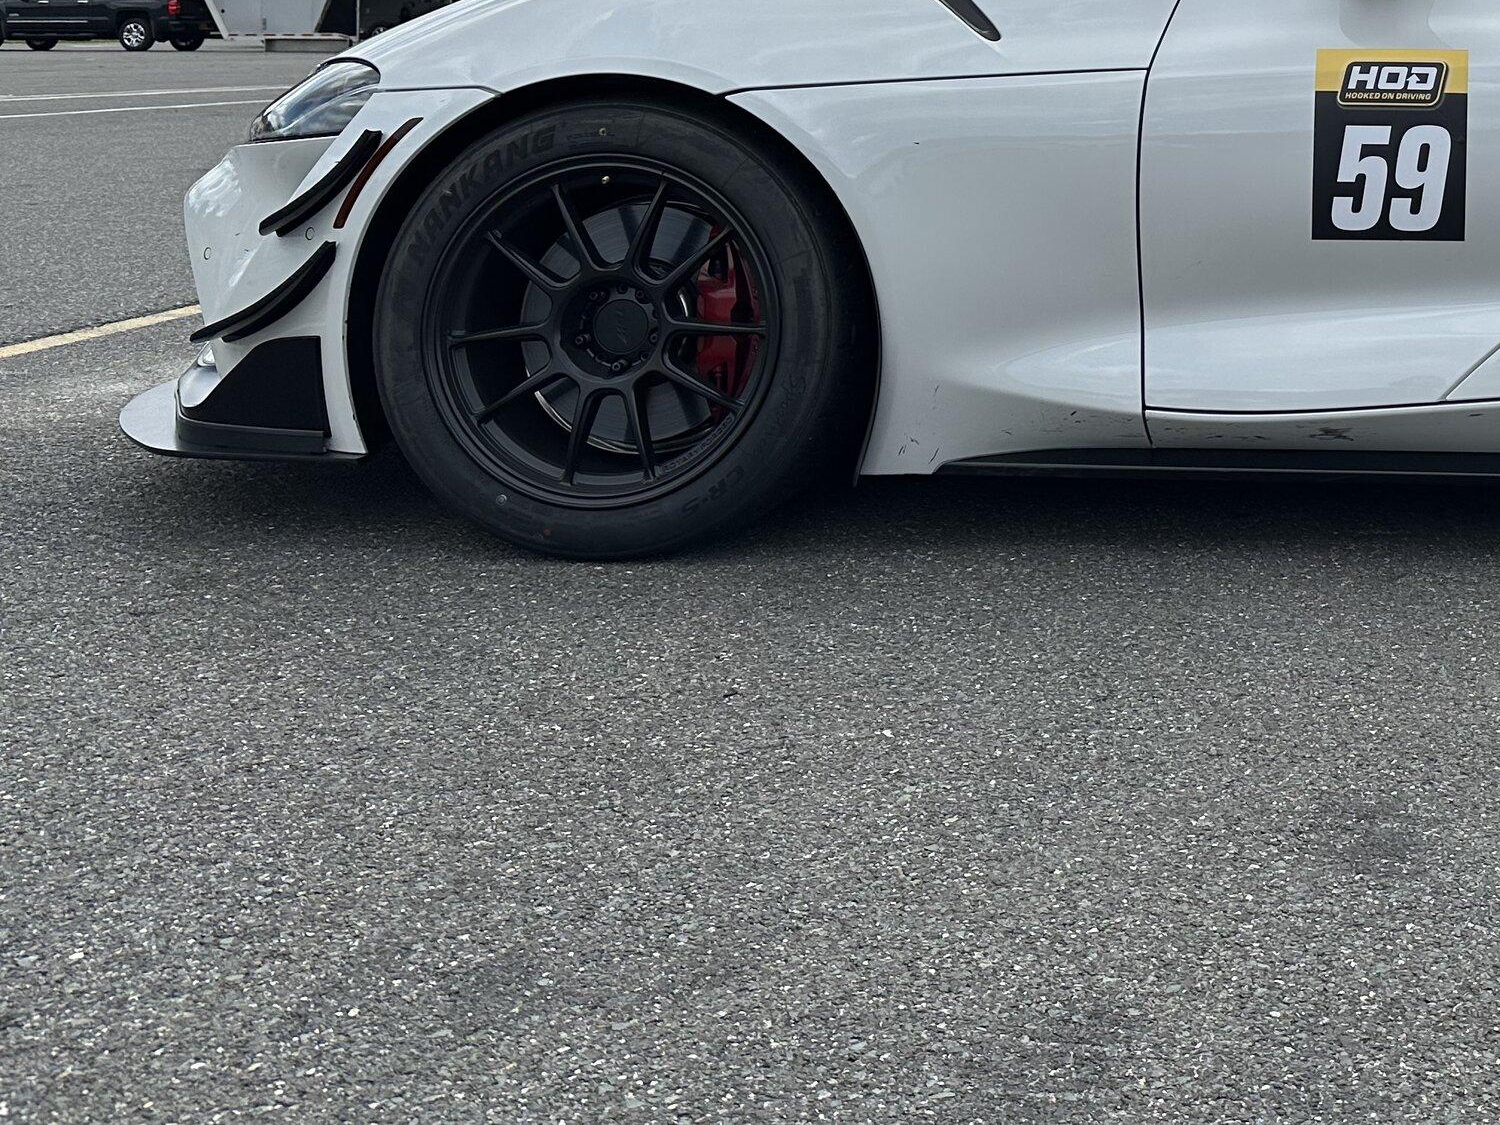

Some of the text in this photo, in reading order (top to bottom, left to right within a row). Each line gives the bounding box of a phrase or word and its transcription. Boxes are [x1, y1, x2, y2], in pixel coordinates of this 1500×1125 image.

[1345, 92, 1381, 100] HOOKED
[1381, 92, 1395, 100] ON
[1347, 65, 1438, 90] HOD
[409, 125, 556, 264] NANKANG
[1331, 124, 1452, 232] 59
